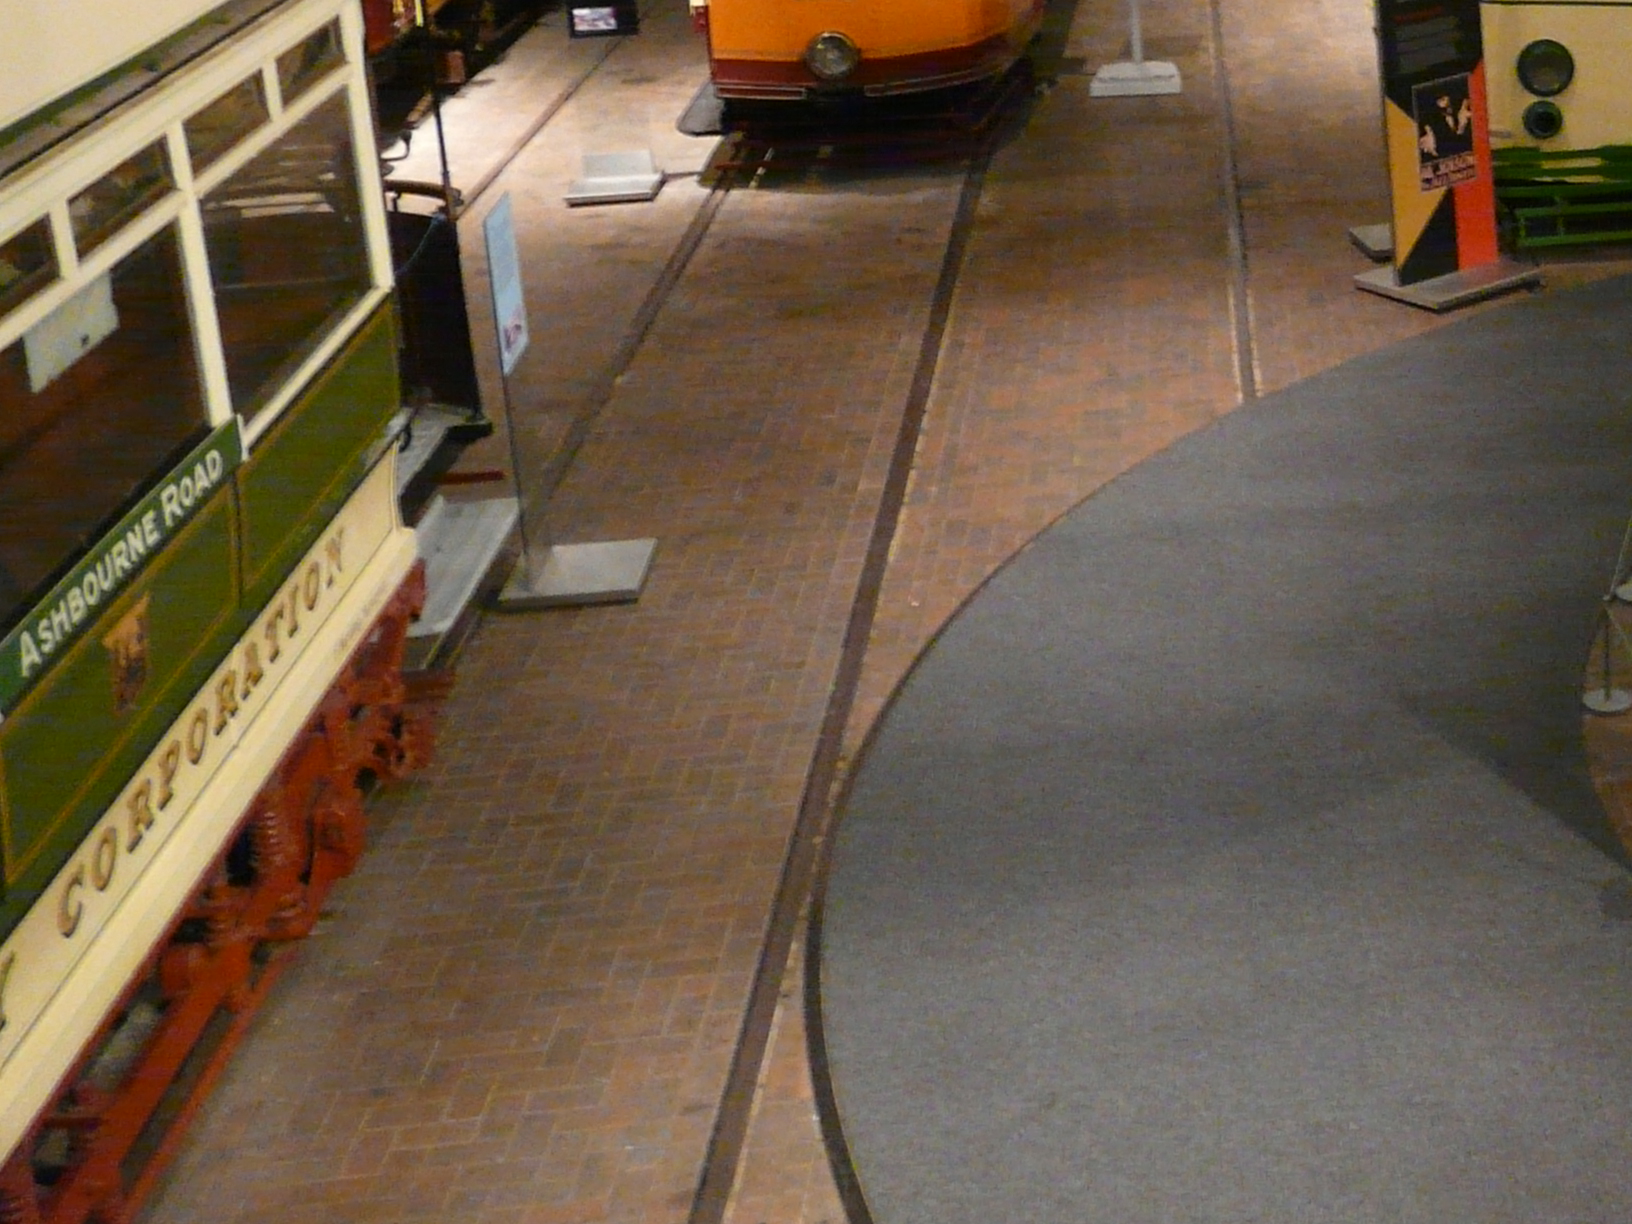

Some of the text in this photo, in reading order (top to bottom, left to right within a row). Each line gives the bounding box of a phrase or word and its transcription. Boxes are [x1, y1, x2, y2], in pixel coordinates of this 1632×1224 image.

[19, 448, 224, 677] ASHBOURNE ROAD
[56, 524, 346, 939] CORPORATION
